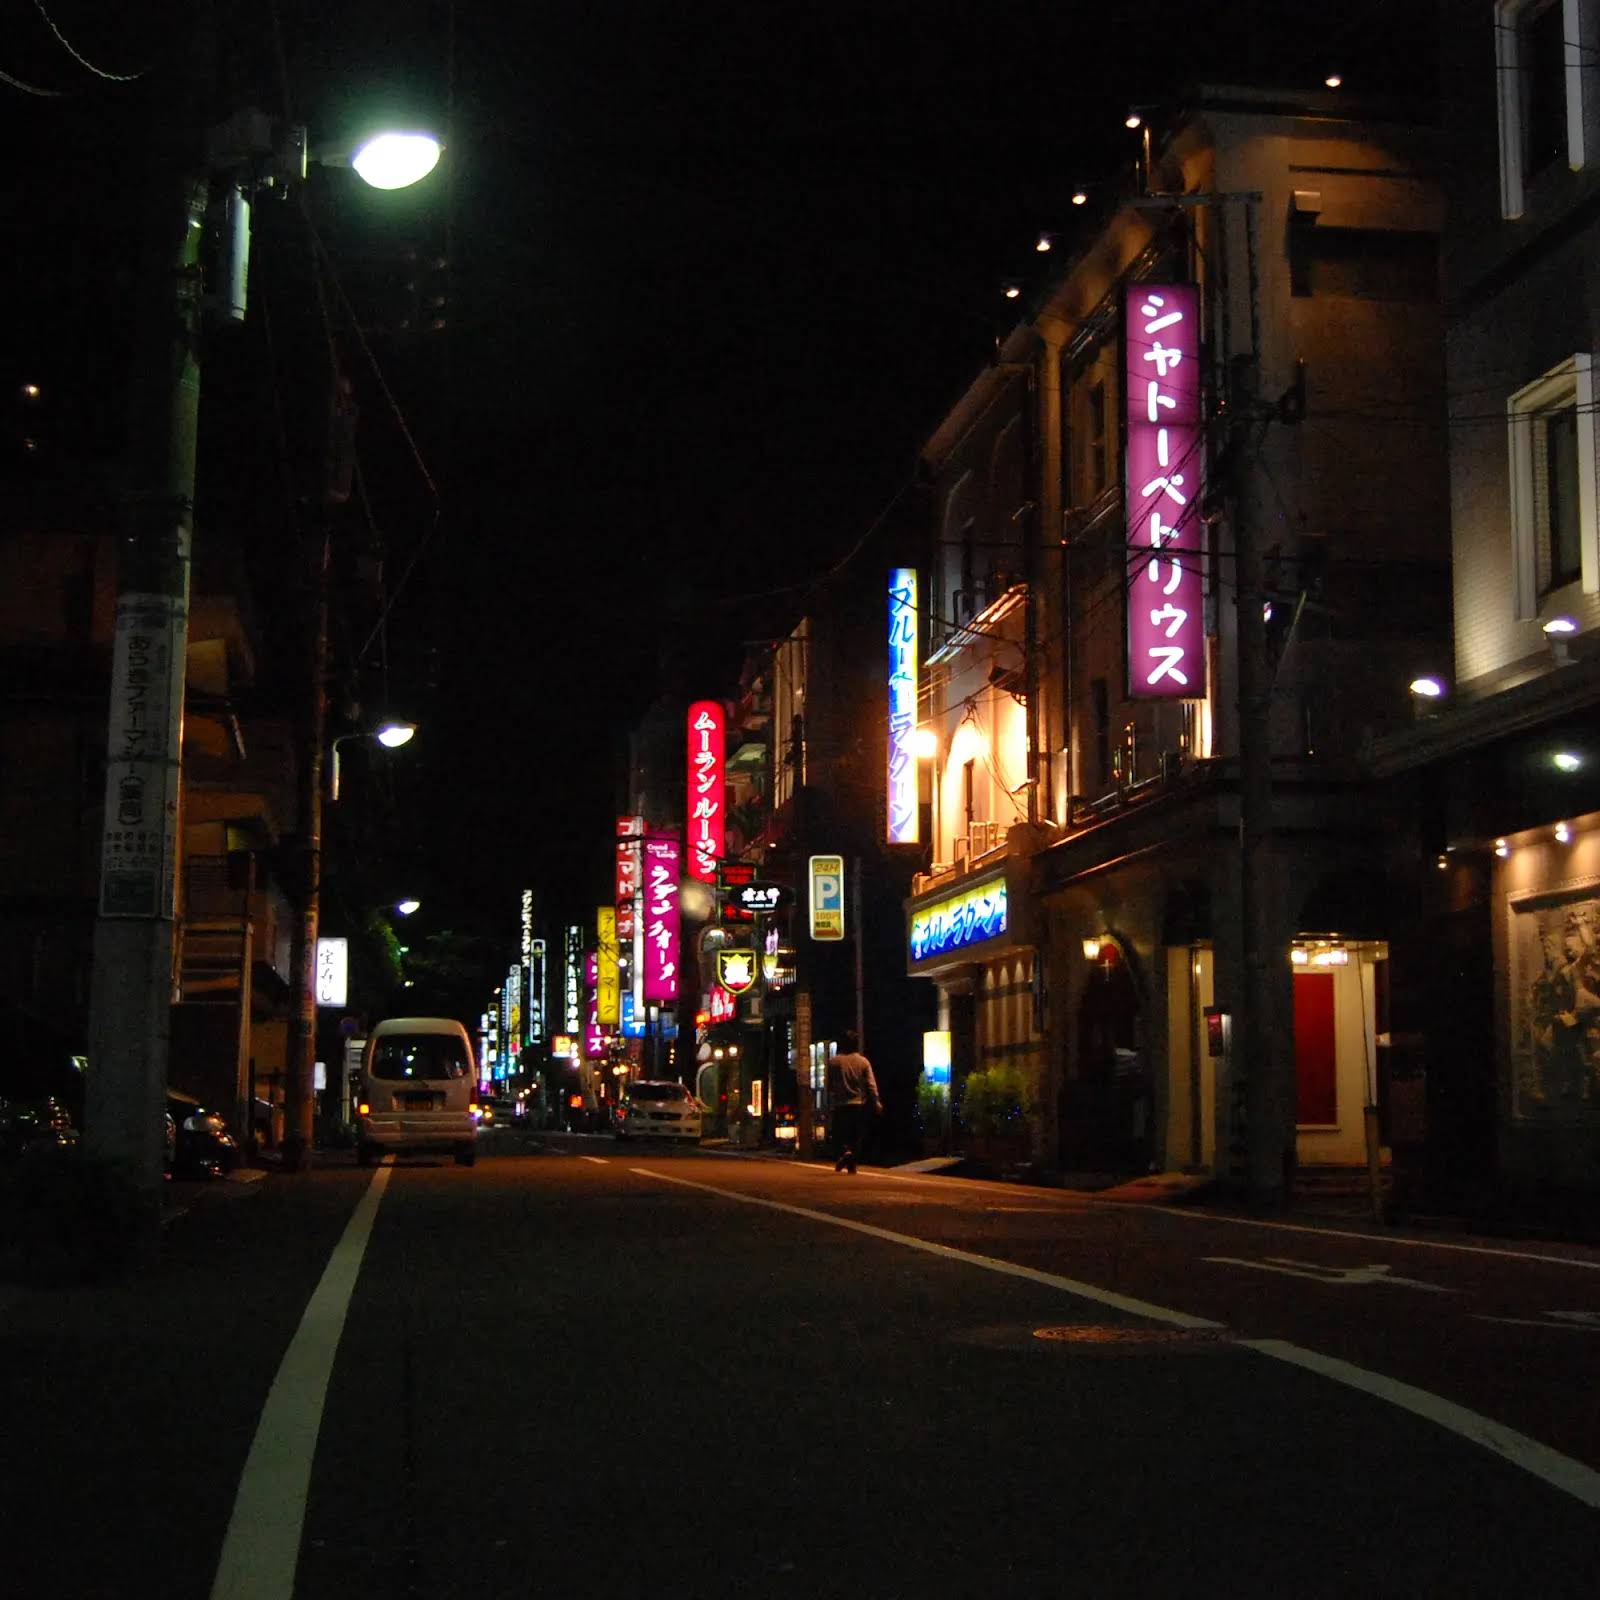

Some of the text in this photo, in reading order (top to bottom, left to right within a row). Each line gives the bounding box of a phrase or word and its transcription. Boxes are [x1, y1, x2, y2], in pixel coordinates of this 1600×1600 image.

[692, 711, 719, 874] ムーランルージュ
[816, 876, 838, 909] P
